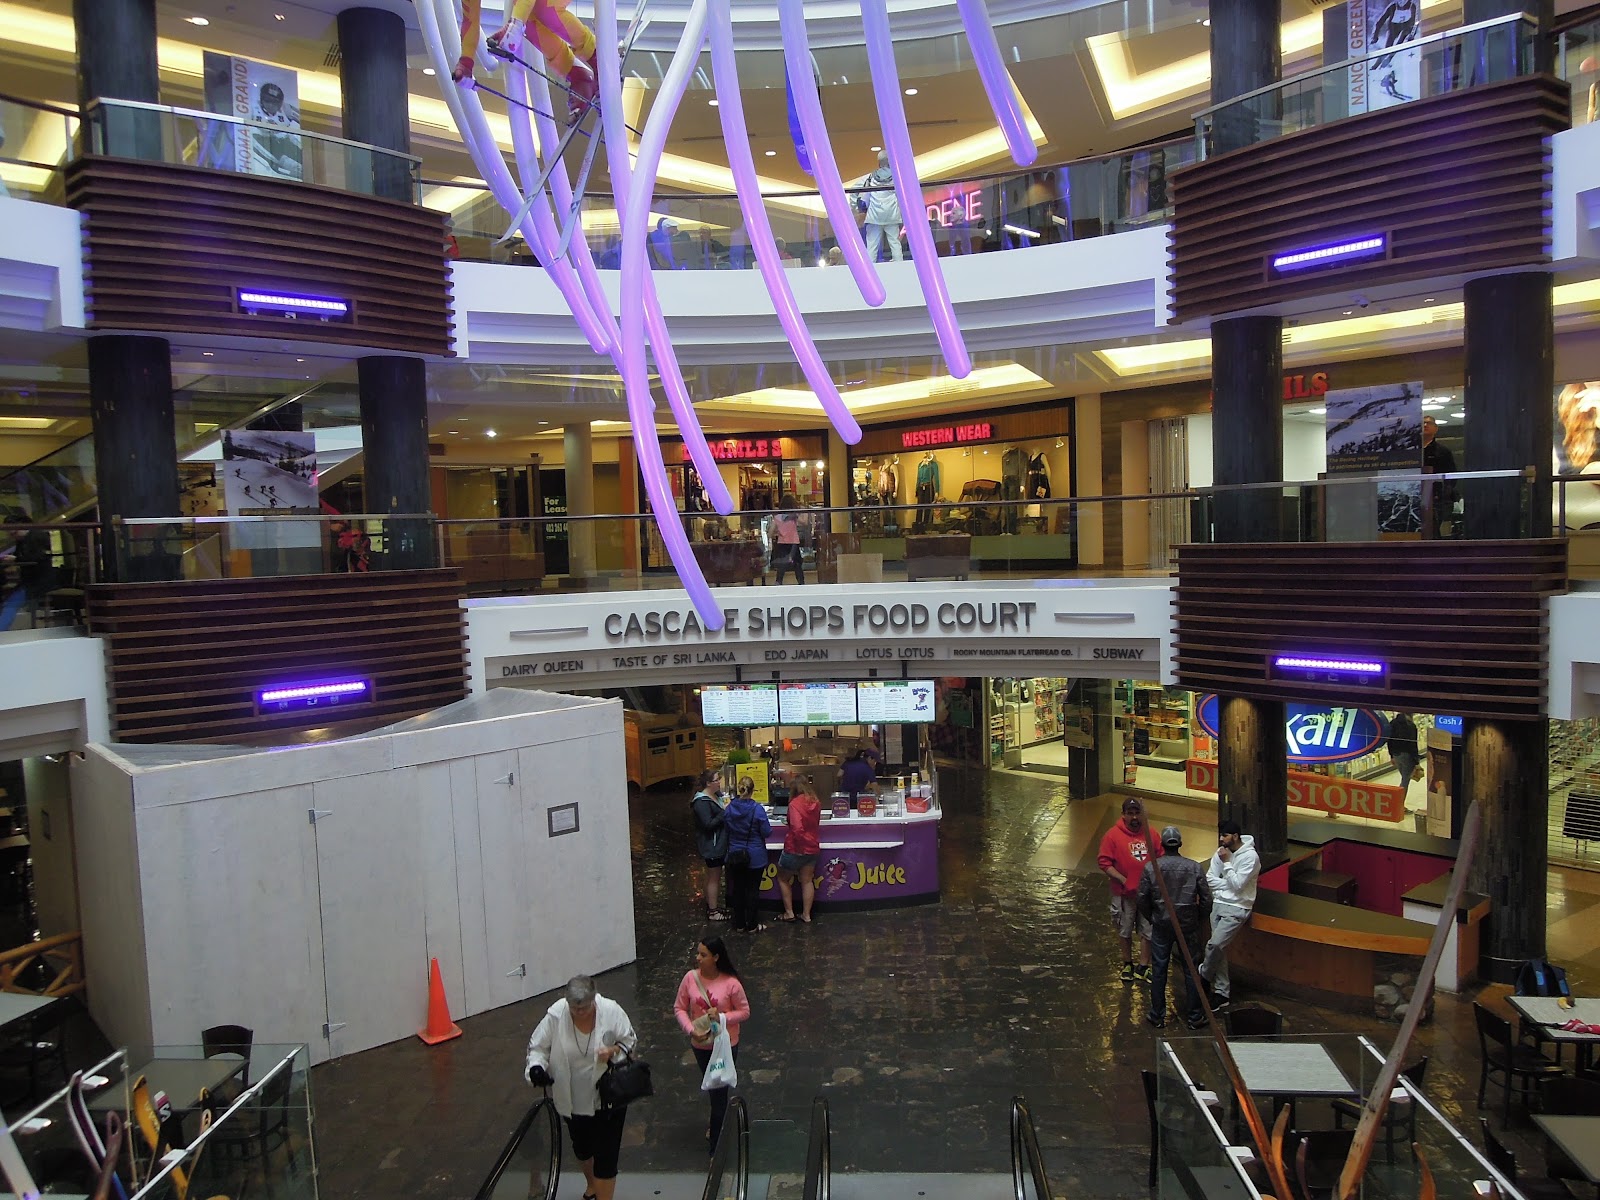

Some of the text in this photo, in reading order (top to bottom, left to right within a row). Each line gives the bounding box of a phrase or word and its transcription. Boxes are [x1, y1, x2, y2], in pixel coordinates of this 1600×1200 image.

[1350, 55, 1364, 106] NANC
[238, 126, 253, 171] HOMA
[902, 423, 991, 448] WESTERN WEAR
[544, 497, 560, 506] For
[604, 602, 1036, 638] CASCAE SHOPS FOOD COURT
[612, 652, 736, 668] TASTE OF SRI LANKA
[764, 649, 829, 661] EDO JAPAN
[856, 647, 935, 659] LOTUS LOTUS
[1092, 648, 1144, 660] SUBWAY
[502, 660, 584, 677] DAIRY QUEEN
[1438, 718, 1456, 726] Cash
[1287, 780, 1392, 817] STORE
[850, 862, 906, 890] Juice
